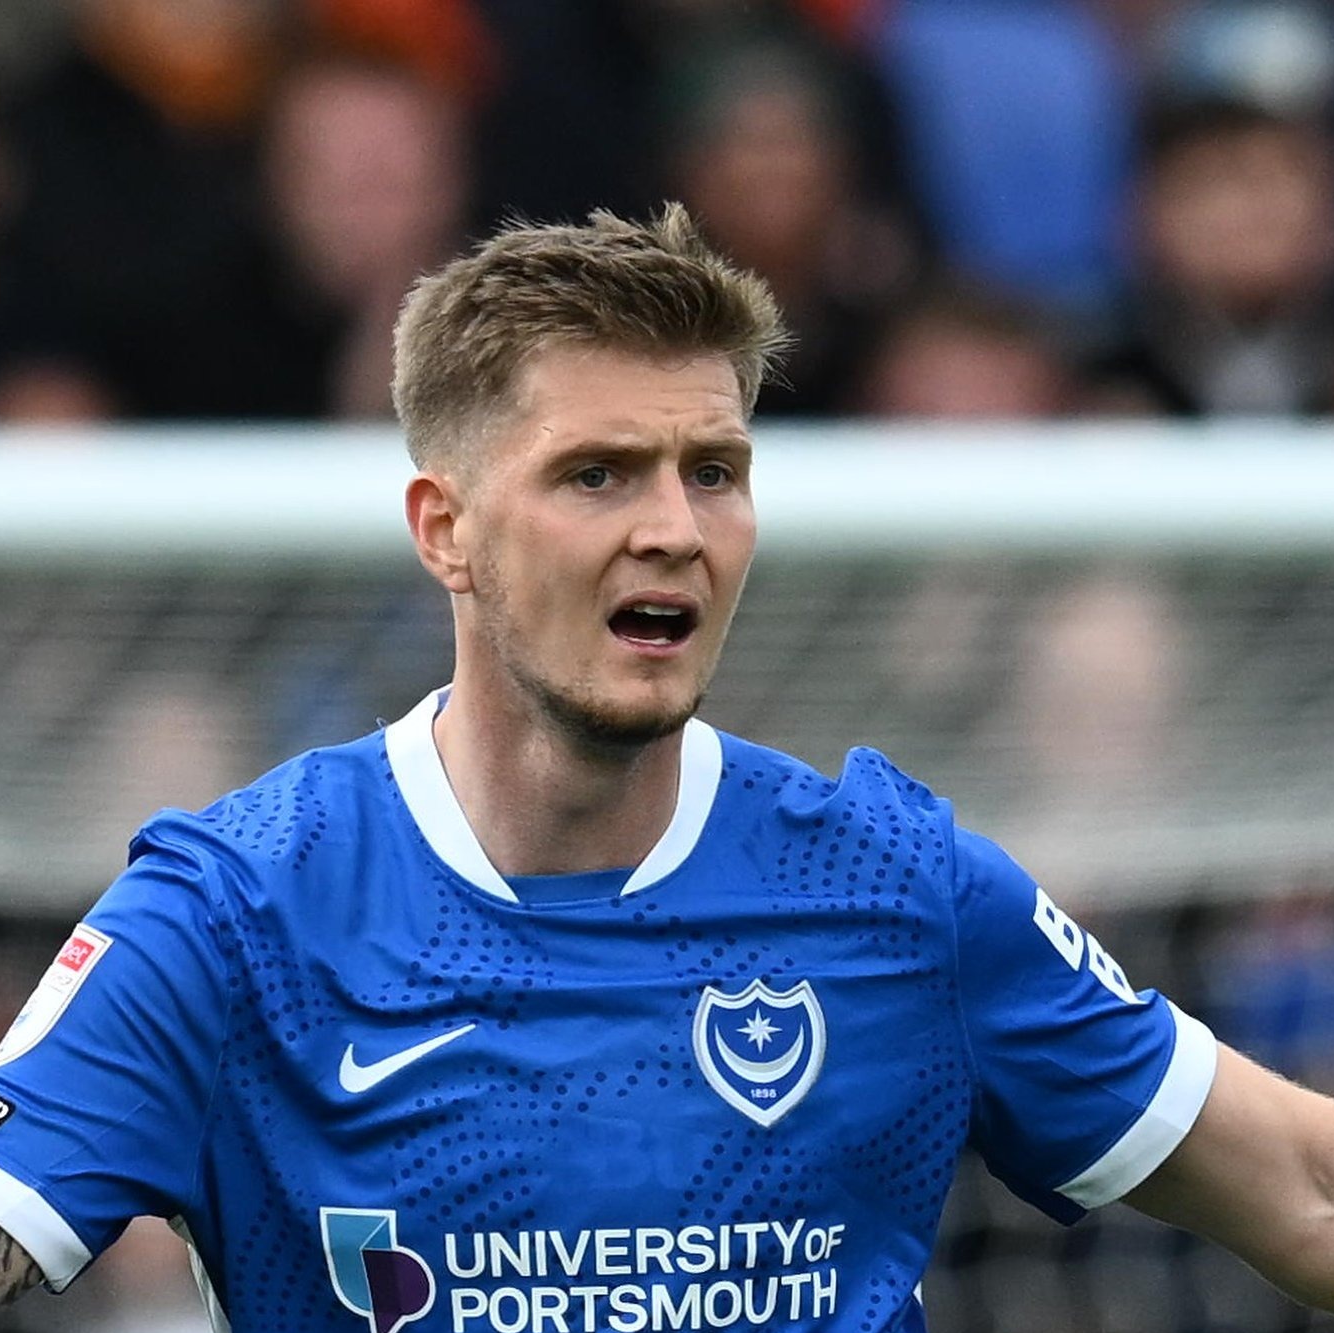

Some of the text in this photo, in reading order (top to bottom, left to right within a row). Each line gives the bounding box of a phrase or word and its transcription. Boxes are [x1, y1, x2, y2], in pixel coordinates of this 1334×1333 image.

[445, 1218, 845, 1278] UNIVERSITY OF
[451, 1268, 837, 1333] PORTSMOUTH
